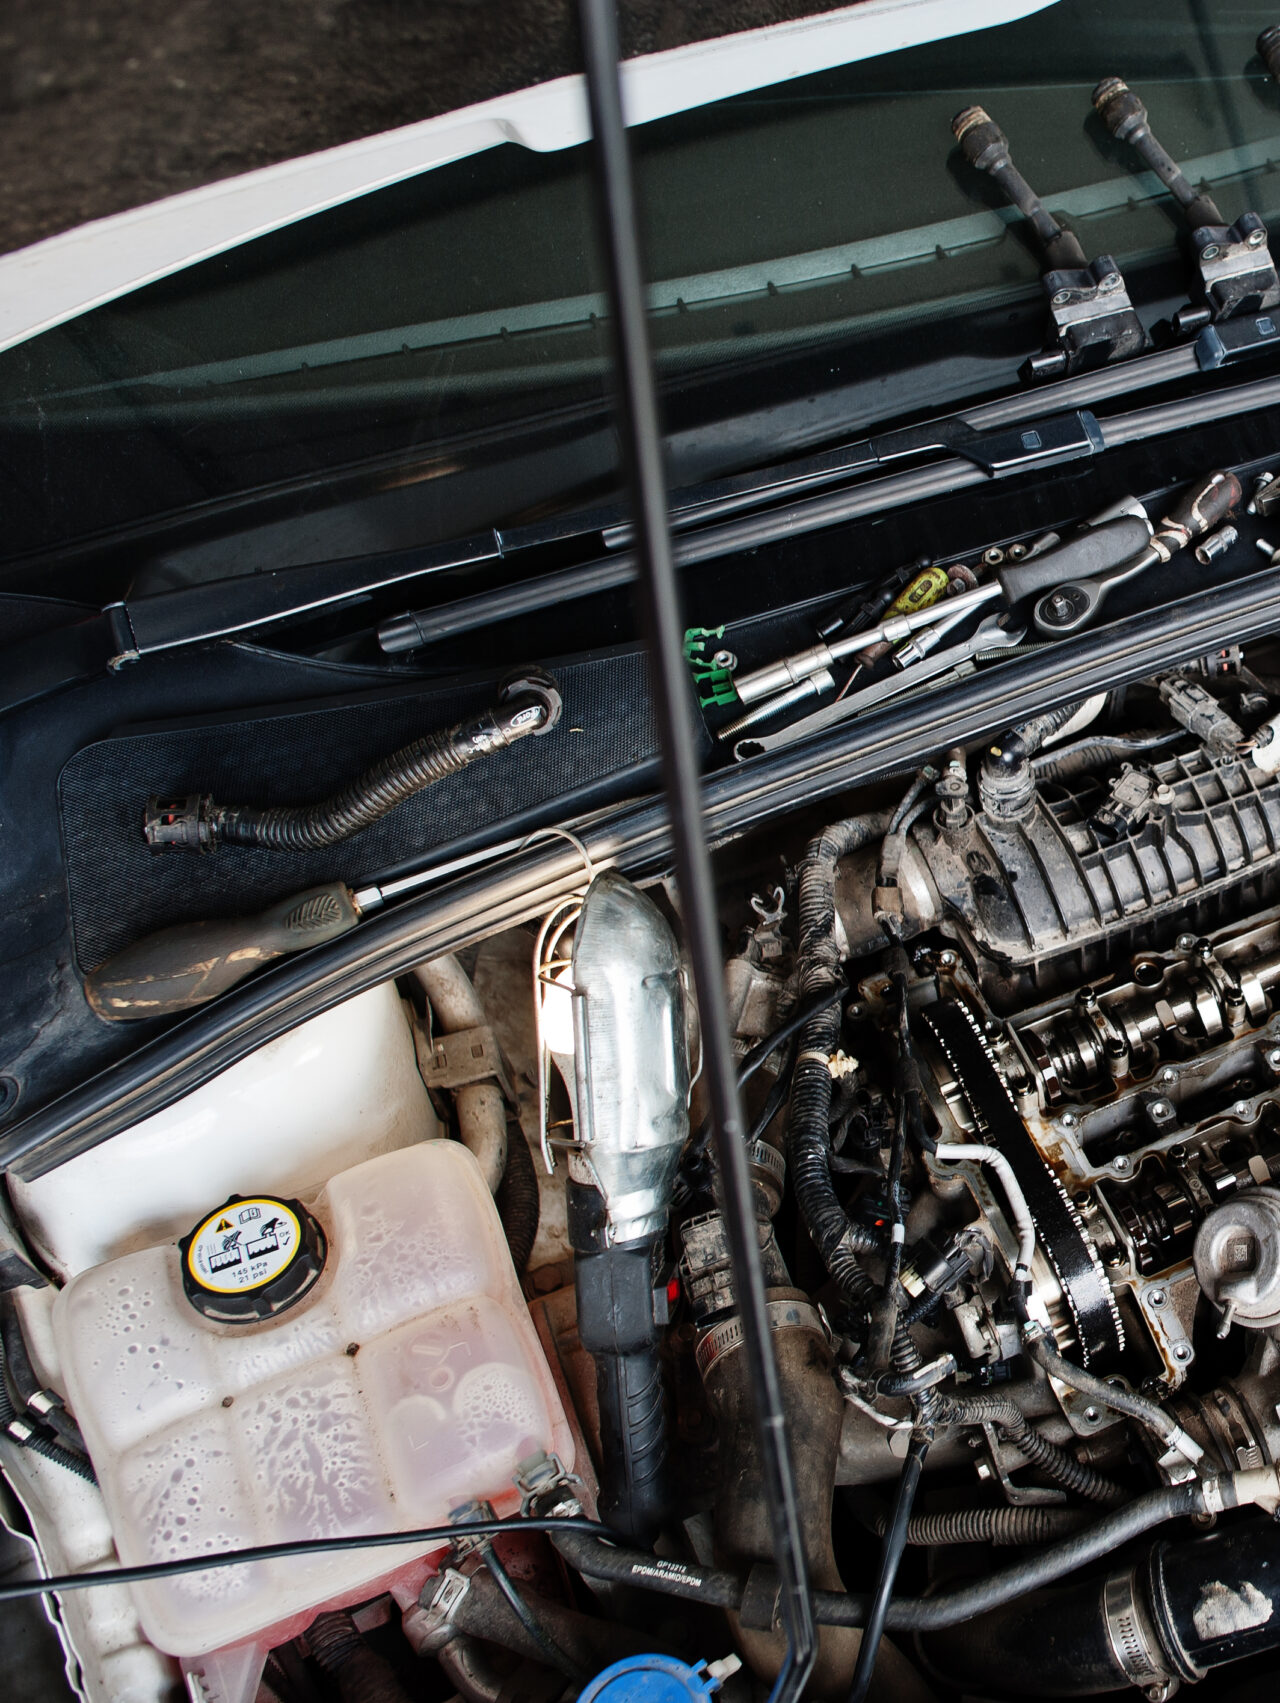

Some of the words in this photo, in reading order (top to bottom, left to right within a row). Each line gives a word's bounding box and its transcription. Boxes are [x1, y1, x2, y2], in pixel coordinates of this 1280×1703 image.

[515, 707, 540, 724] Ford
[279, 1230, 290, 1238] OK
[232, 1267, 248, 1278] 145
[251, 1261, 268, 1271] kPa
[239, 1275, 250, 1284] 21
[252, 1269, 268, 1280] psi
[631, 1564, 702, 1587] EPDM/ARAMID/EPDM
